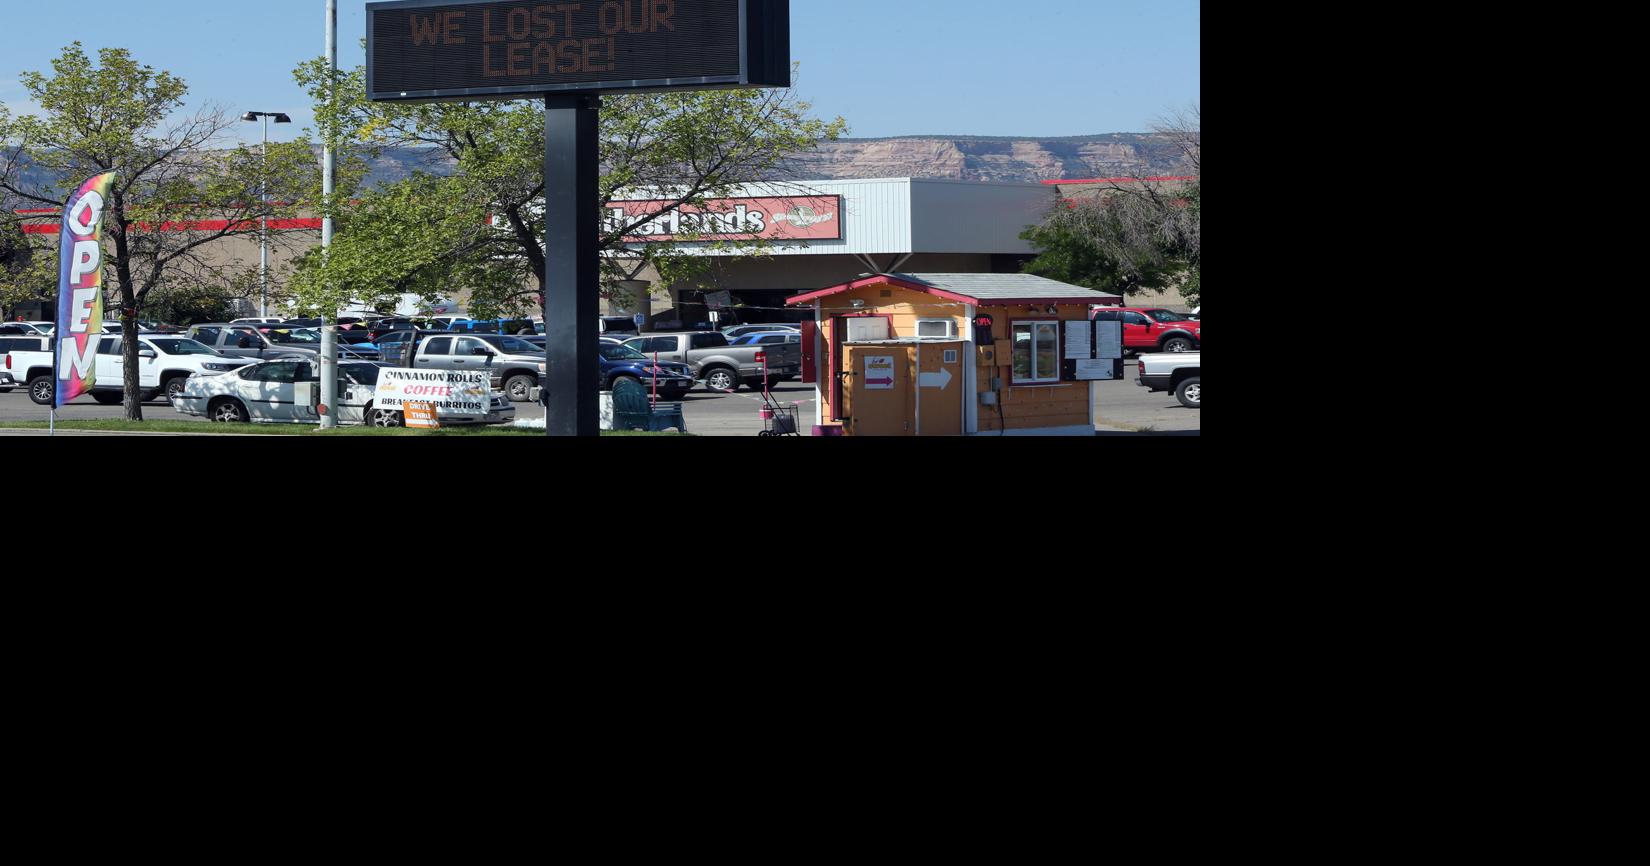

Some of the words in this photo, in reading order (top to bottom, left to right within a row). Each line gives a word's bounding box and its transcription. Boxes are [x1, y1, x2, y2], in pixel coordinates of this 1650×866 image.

[410, 11, 466, 46] WE
[483, 4, 580, 42] LOST
[599, 0, 675, 33] OUR
[483, 36, 615, 78] LEASE!
[59, 189, 104, 381] OPEN
[976, 317, 992, 326] OPEN
[385, 371, 444, 381] CINNAMON
[446, 373, 482, 383] ROLLS
[403, 385, 453, 396] COFFEE
[433, 400, 482, 409] BURRITOS
